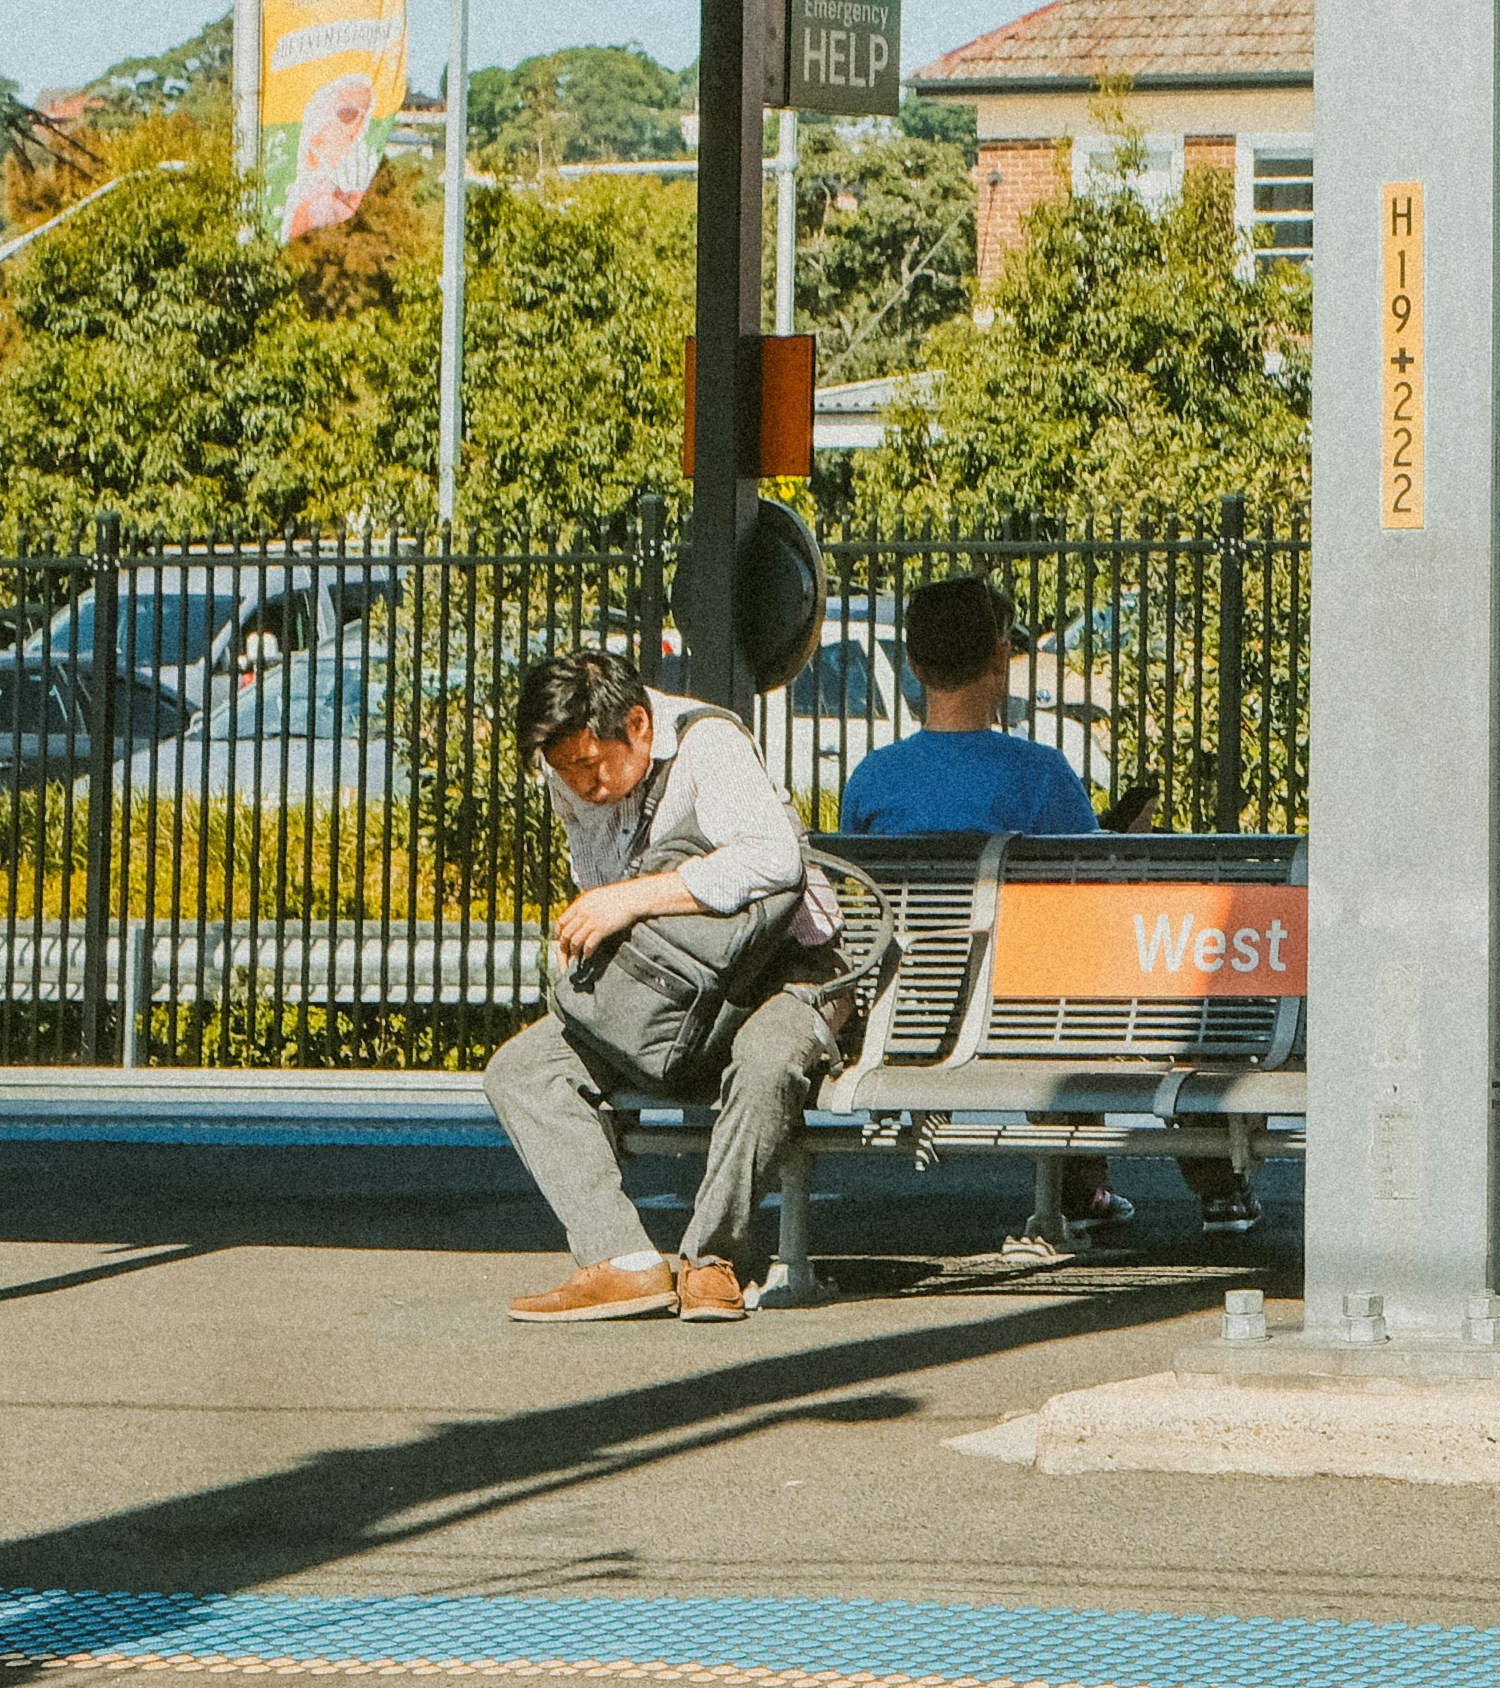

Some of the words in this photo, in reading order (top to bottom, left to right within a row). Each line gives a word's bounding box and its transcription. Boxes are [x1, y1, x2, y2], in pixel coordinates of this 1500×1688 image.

[803, 26, 889, 88] HELP
[1390, 196, 1415, 513] H19+222
[1132, 912, 1290, 973] West
